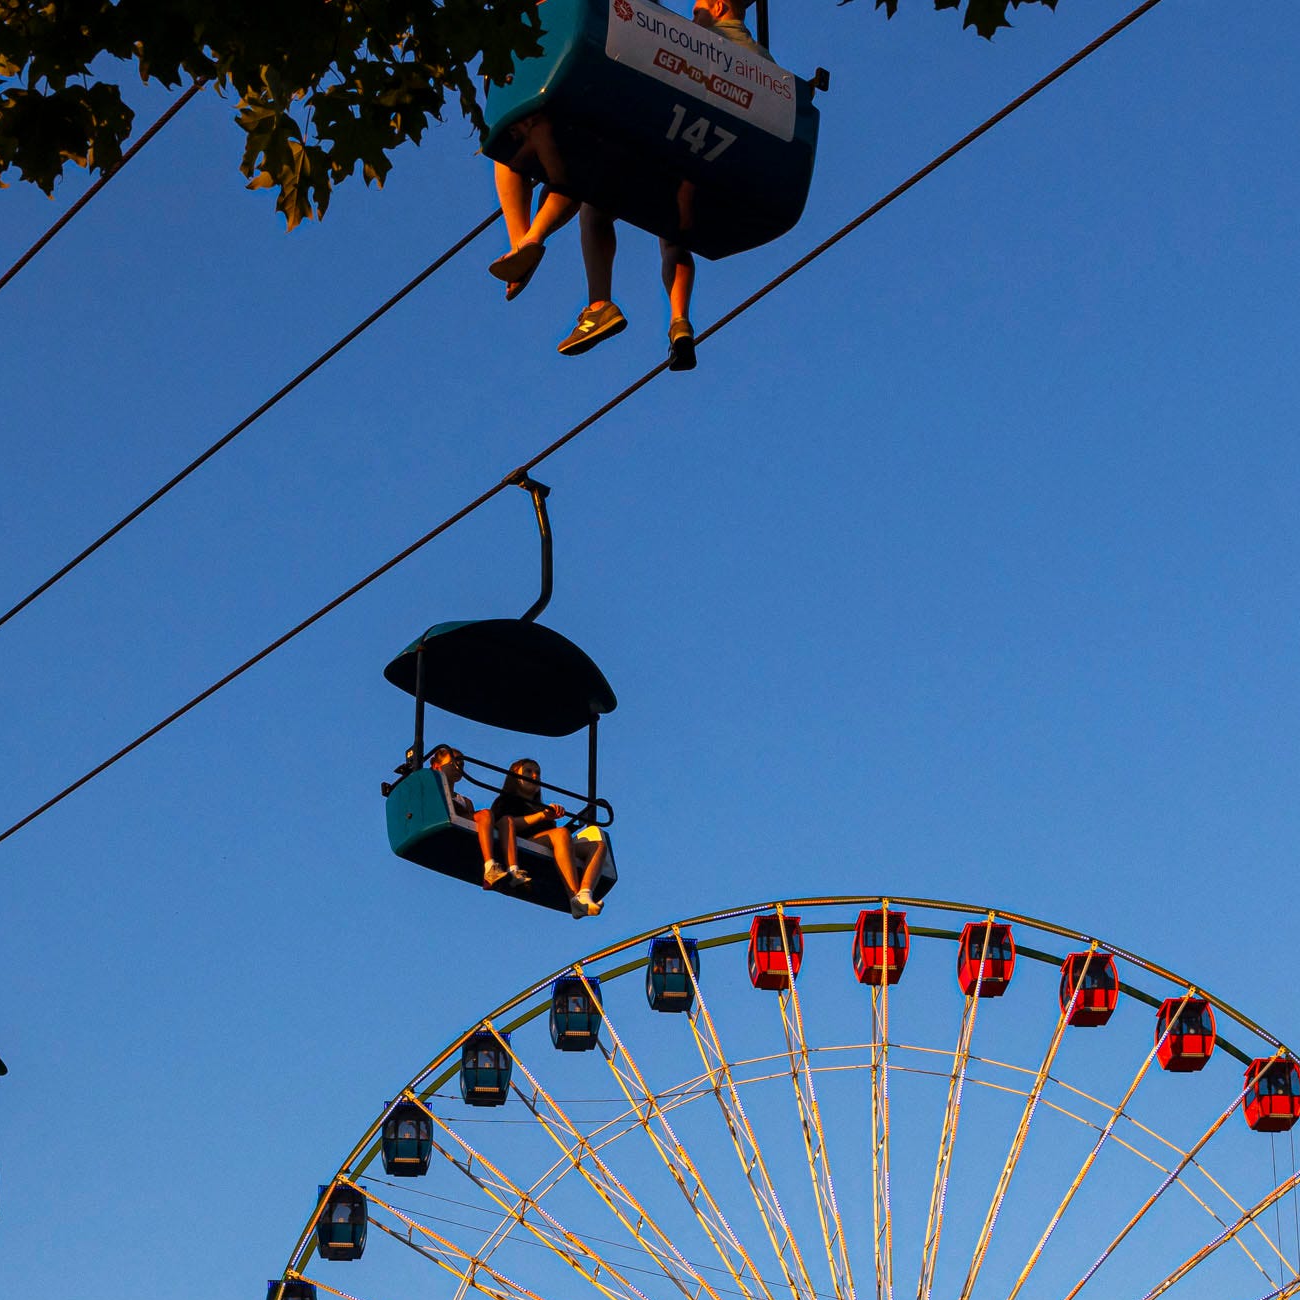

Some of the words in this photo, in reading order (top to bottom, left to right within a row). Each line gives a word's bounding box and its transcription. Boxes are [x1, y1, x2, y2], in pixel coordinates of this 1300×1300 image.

[637, 11, 667, 38] sun
[669, 26, 732, 72] country
[735, 60, 792, 99] airlines
[658, 51, 682, 72] GET
[690, 69, 701, 80] TO
[712, 77, 749, 105] GOING
[665, 104, 738, 162] 147
